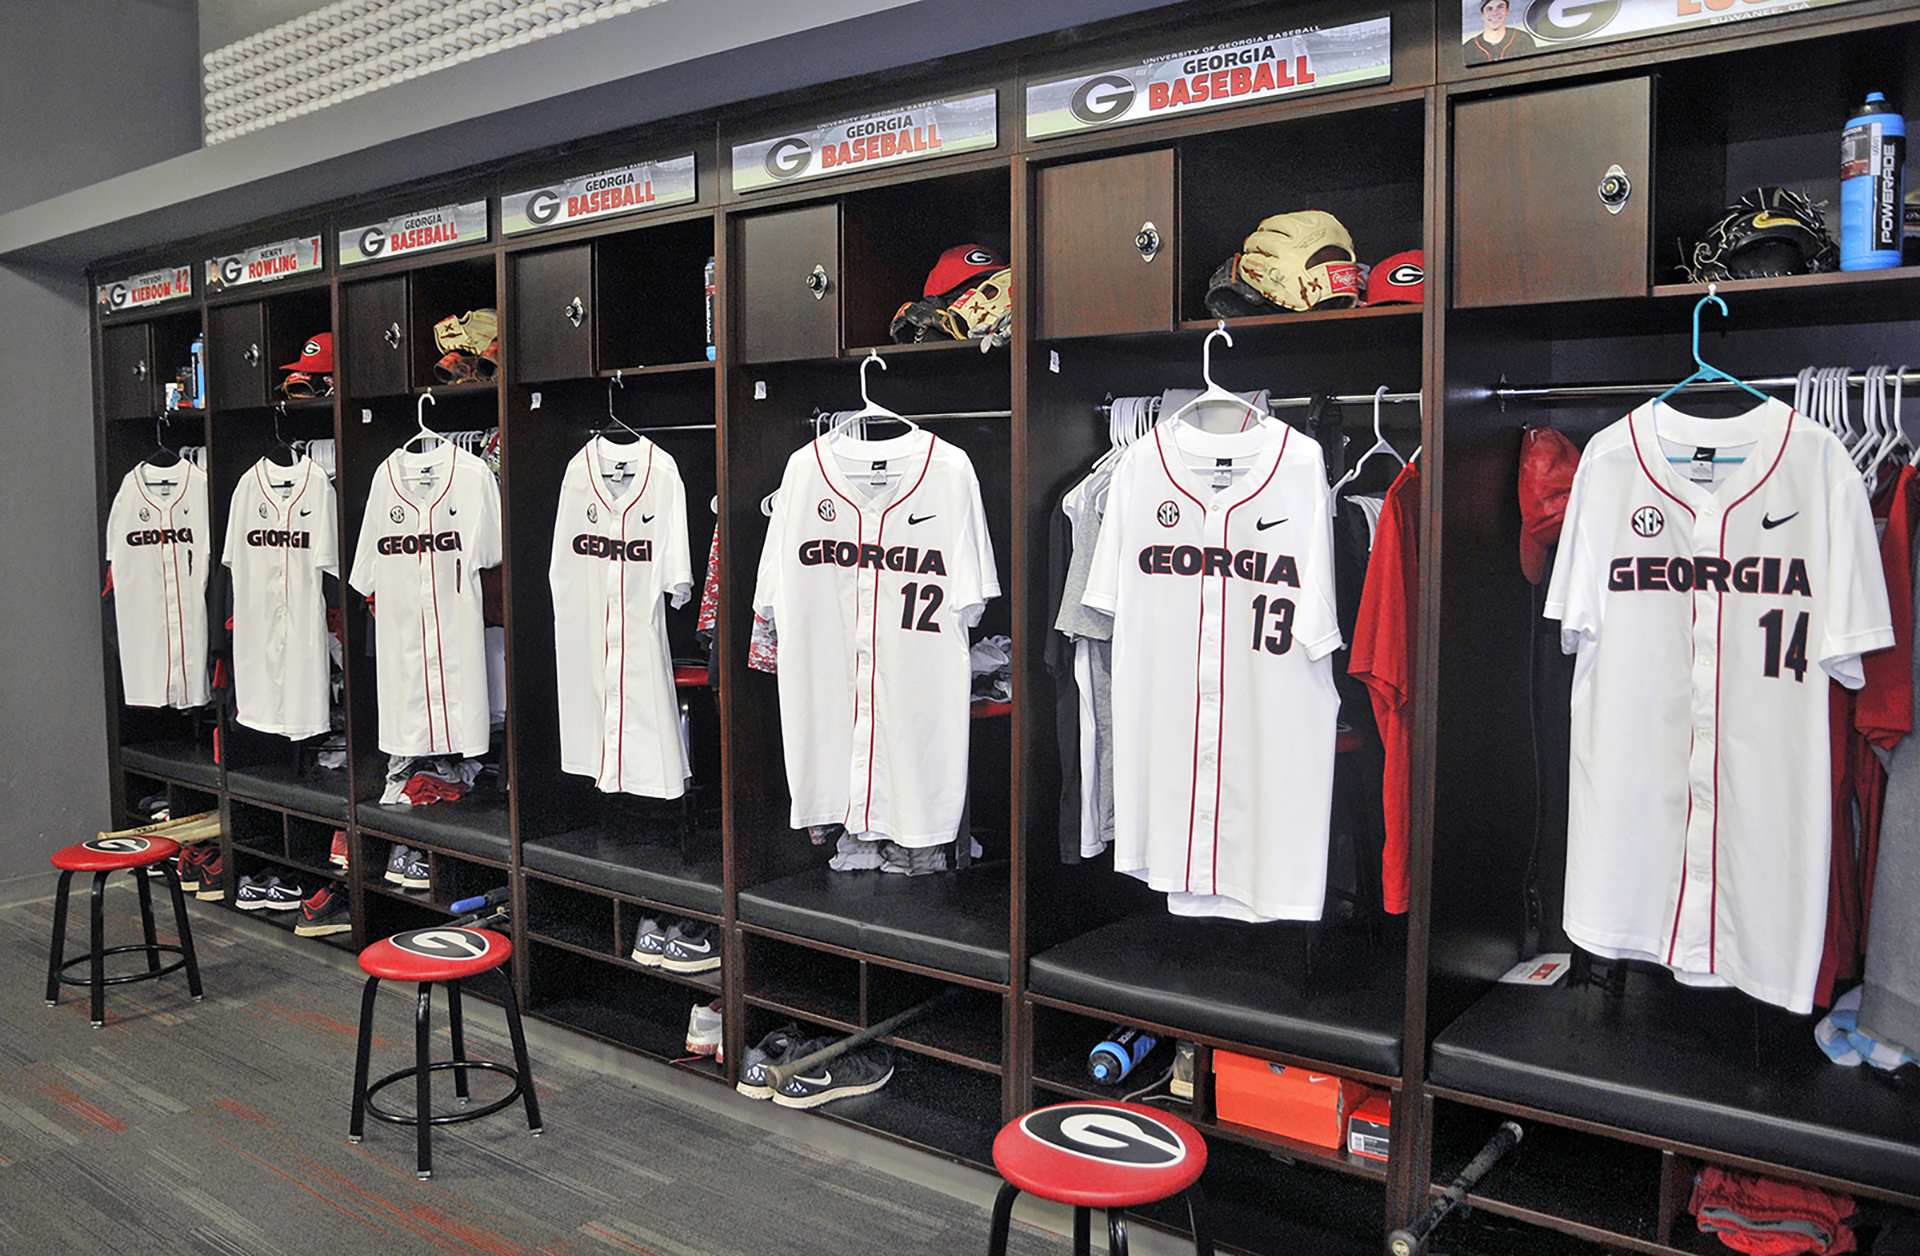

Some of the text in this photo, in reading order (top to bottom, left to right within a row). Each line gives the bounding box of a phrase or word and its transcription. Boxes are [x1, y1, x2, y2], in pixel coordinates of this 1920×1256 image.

[1524, 0, 1621, 41] G
[1788, 2, 1810, 12] GA
[1142, 25, 1321, 65] UNIVERSITY OF GEORGIA BASEBALL
[1182, 45, 1276, 75] GEORGIA
[1149, 55, 1316, 111] BASEBALL
[1070, 74, 1136, 124] G
[846, 115, 913, 138] GEORGIA
[765, 137, 812, 180] G
[822, 124, 942, 169] BASEBALL
[586, 172, 635, 192] GEORGIA
[1881, 144, 1896, 244] POWERADE
[526, 190, 560, 224] G
[568, 181, 656, 218] BASEBALL
[391, 222, 458, 252] BASEBALL
[404, 214, 442, 230] GEORGIA
[260, 248, 283, 259] HENRY
[311, 238, 319, 266] 7
[359, 226, 386, 257] G
[175, 268, 189, 293] 42
[222, 257, 242, 283] G
[248, 254, 297, 278] ROWLING
[110, 284, 127, 306] G
[131, 282, 171, 303] KIEBOOM
[1158, 502, 1179, 526] SEC
[1633, 506, 1663, 537] SEC
[799, 540, 948, 577] GEORGIA
[1608, 556, 1812, 598] GEORGIA
[900, 582, 944, 634] 12
[1252, 594, 1296, 656] 13
[1758, 608, 1810, 684] 14
